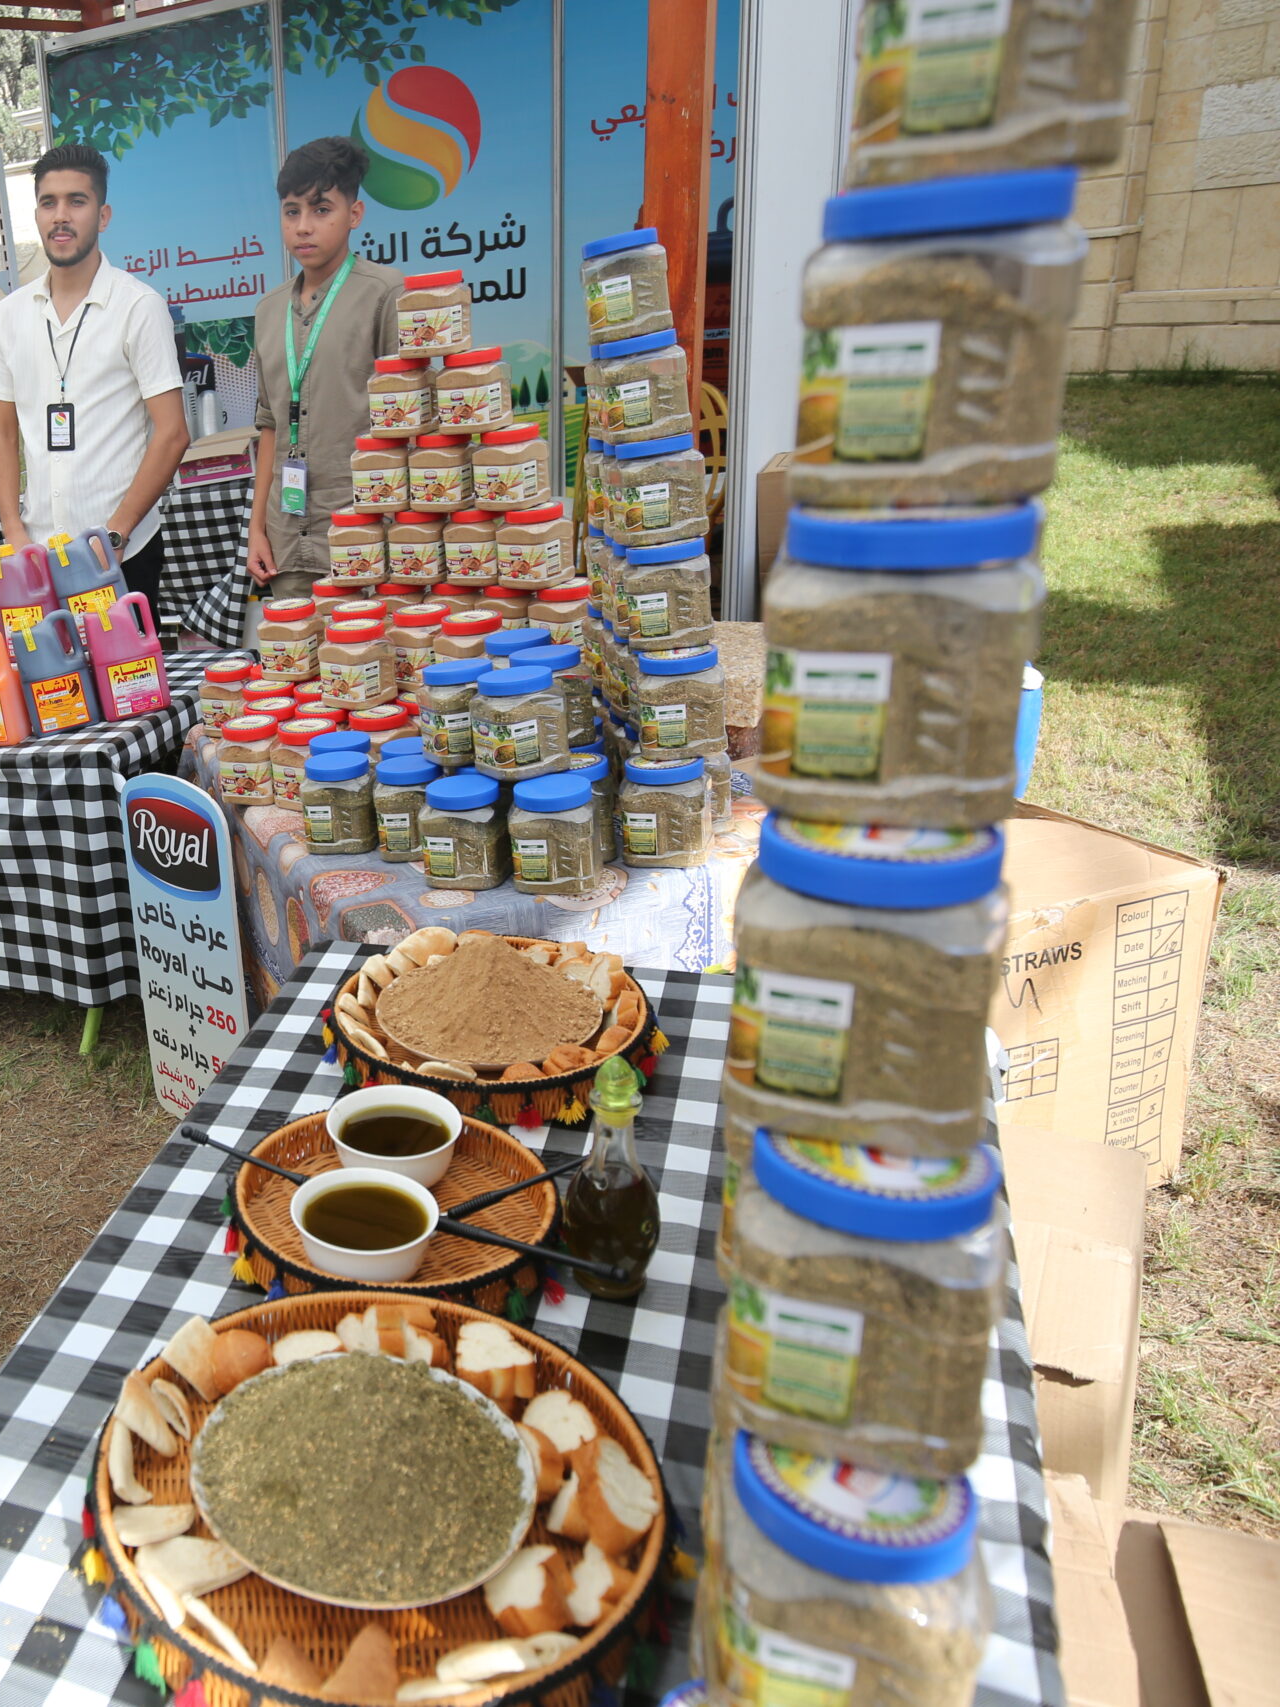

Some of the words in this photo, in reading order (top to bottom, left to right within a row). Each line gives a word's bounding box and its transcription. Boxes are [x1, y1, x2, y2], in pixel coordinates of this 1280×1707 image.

[421, 212, 526, 263] شركة
[124, 248, 169, 277] الزعت
[166, 274, 266, 310] الفلسطين
[113, 659, 152, 680] الشام
[36, 678, 71, 698] الشام
[133, 809, 210, 868] Royal
[137, 901, 177, 931] خاص
[1121, 910, 1150, 923] Colour
[182, 915, 228, 951] عرض
[140, 935, 187, 976] Royal
[1000, 942, 1082, 976] STRAWS
[1124, 942, 1145, 954] Date
[1117, 975, 1147, 989] Machine
[148, 980, 174, 1010] زعتر
[175, 995, 204, 1024] جرام
[1121, 1000, 1142, 1013] Shift
[207, 1006, 237, 1035] 250
[1115, 1031, 1145, 1044] Screening
[180, 1043, 210, 1074] جرام
[1115, 1057, 1141, 1070] Packing
[156, 1060, 183, 1083] شيكل
[184, 1074, 196, 1091] 10
[1113, 1082, 1139, 1095] Counter
[1110, 1106, 1138, 1119] Quantity
[1119, 1115, 1135, 1125] 1000
[1107, 1133, 1136, 1147] Weight
